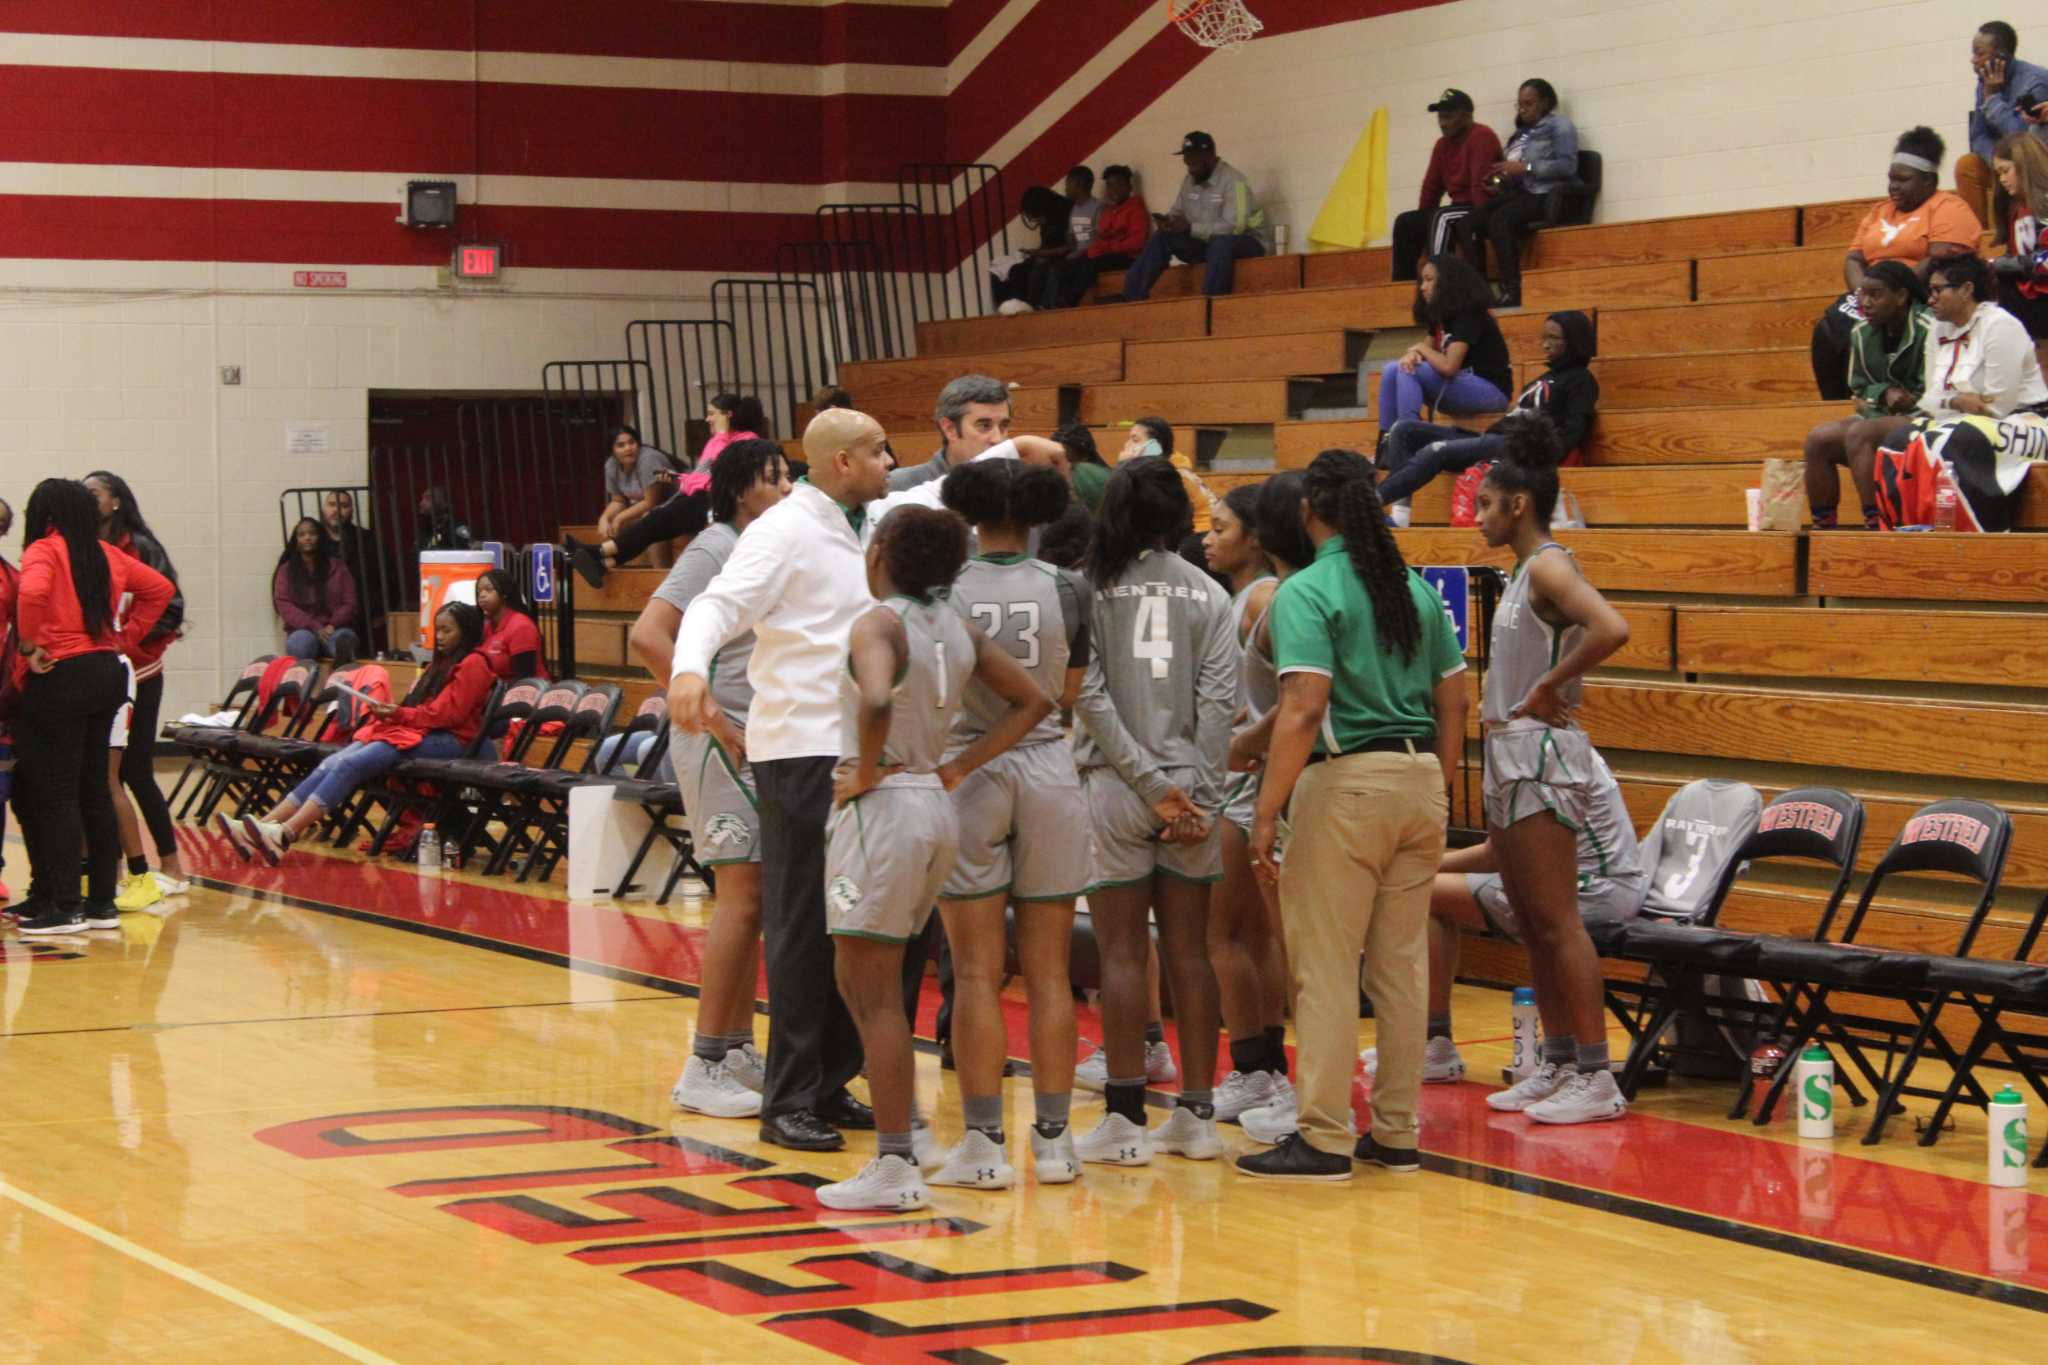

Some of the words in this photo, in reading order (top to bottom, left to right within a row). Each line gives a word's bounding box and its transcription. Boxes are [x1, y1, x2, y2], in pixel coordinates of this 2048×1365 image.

[463, 249, 496, 273] EXIT
[970, 601, 1040, 668] 23
[1133, 596, 1173, 678] 4
[1758, 801, 1844, 842] WESTFIELD
[1900, 812, 1991, 855] WESTFIELD
[1803, 1074, 1832, 1120] S
[2002, 1117, 2028, 1168] S
[253, 1104, 1490, 1365] TFIELD
